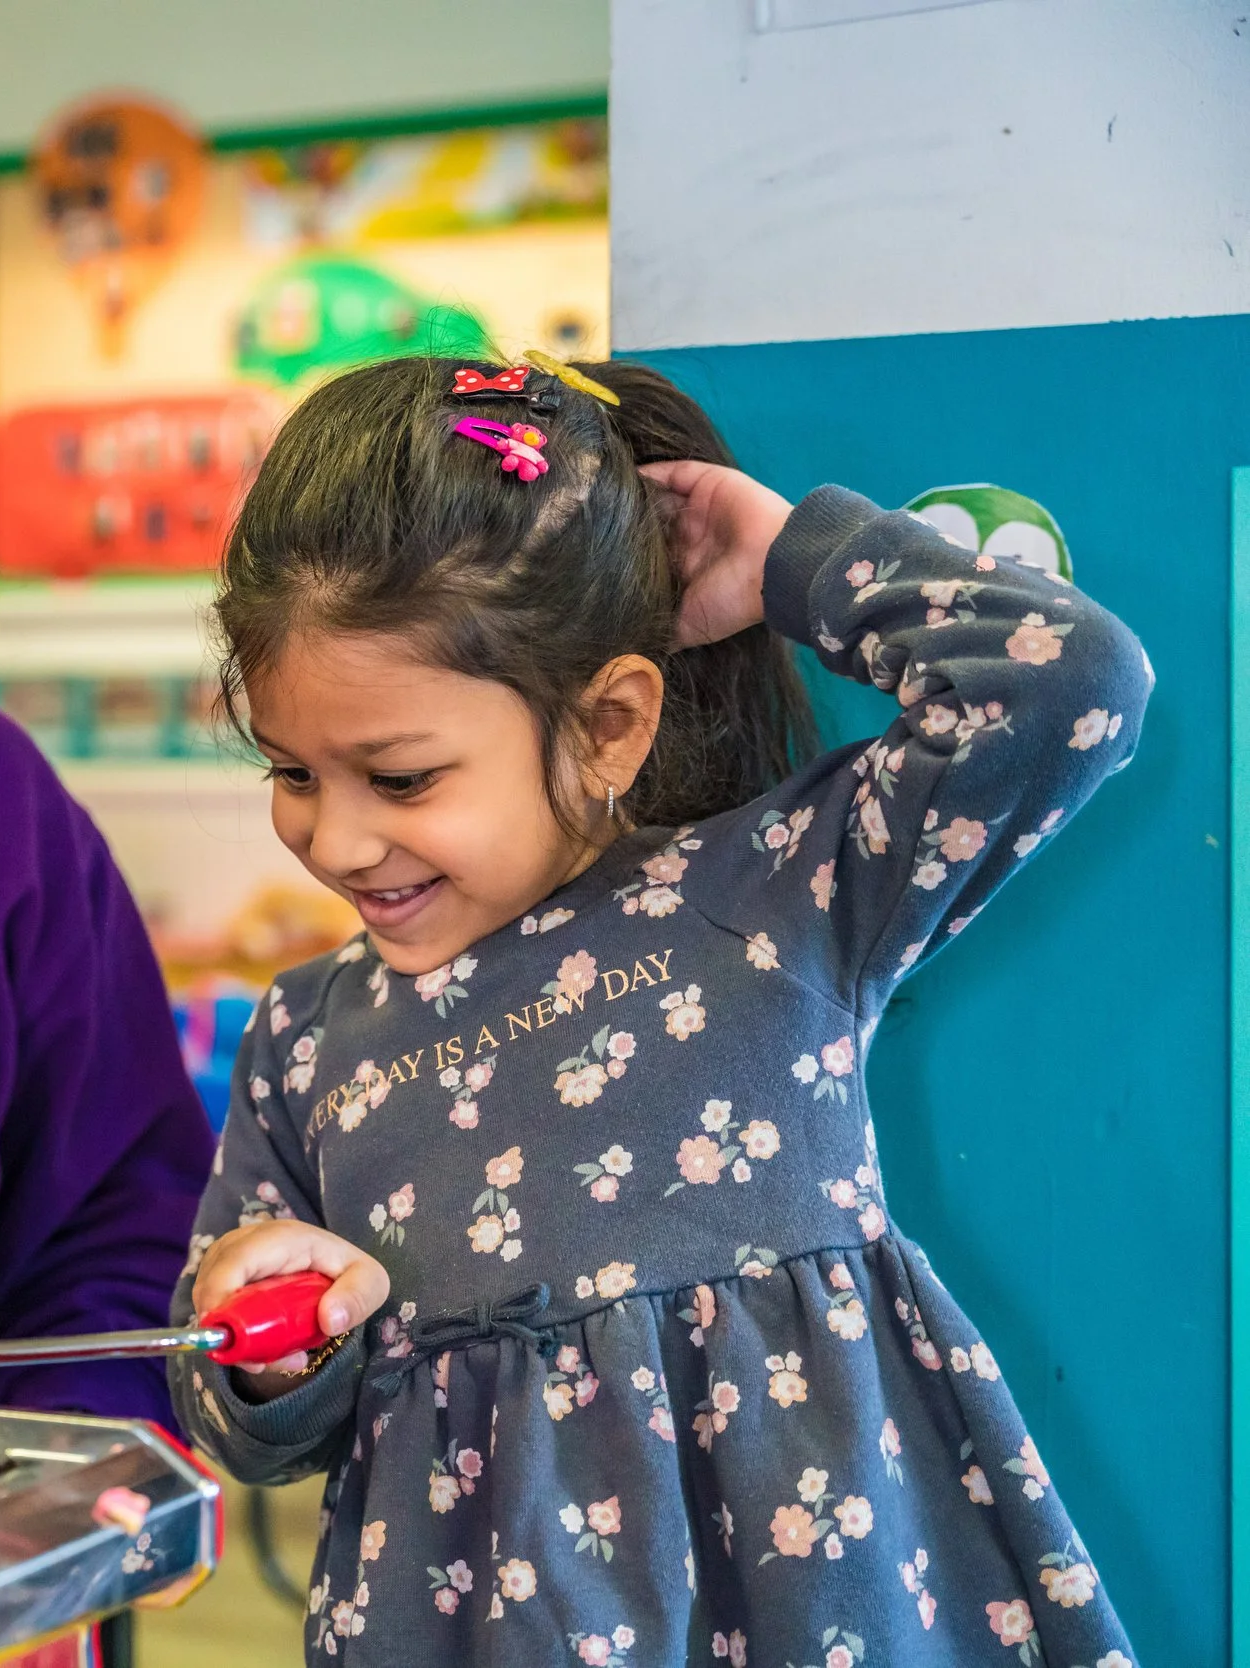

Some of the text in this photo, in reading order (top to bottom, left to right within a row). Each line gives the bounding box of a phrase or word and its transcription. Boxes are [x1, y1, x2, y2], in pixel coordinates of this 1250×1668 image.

[365, 1049, 423, 1097] DAY
[434, 1036, 463, 1070] IS
[474, 1025, 500, 1054] A
[504, 979, 589, 1040] NEW
[600, 949, 673, 1000] DAY
